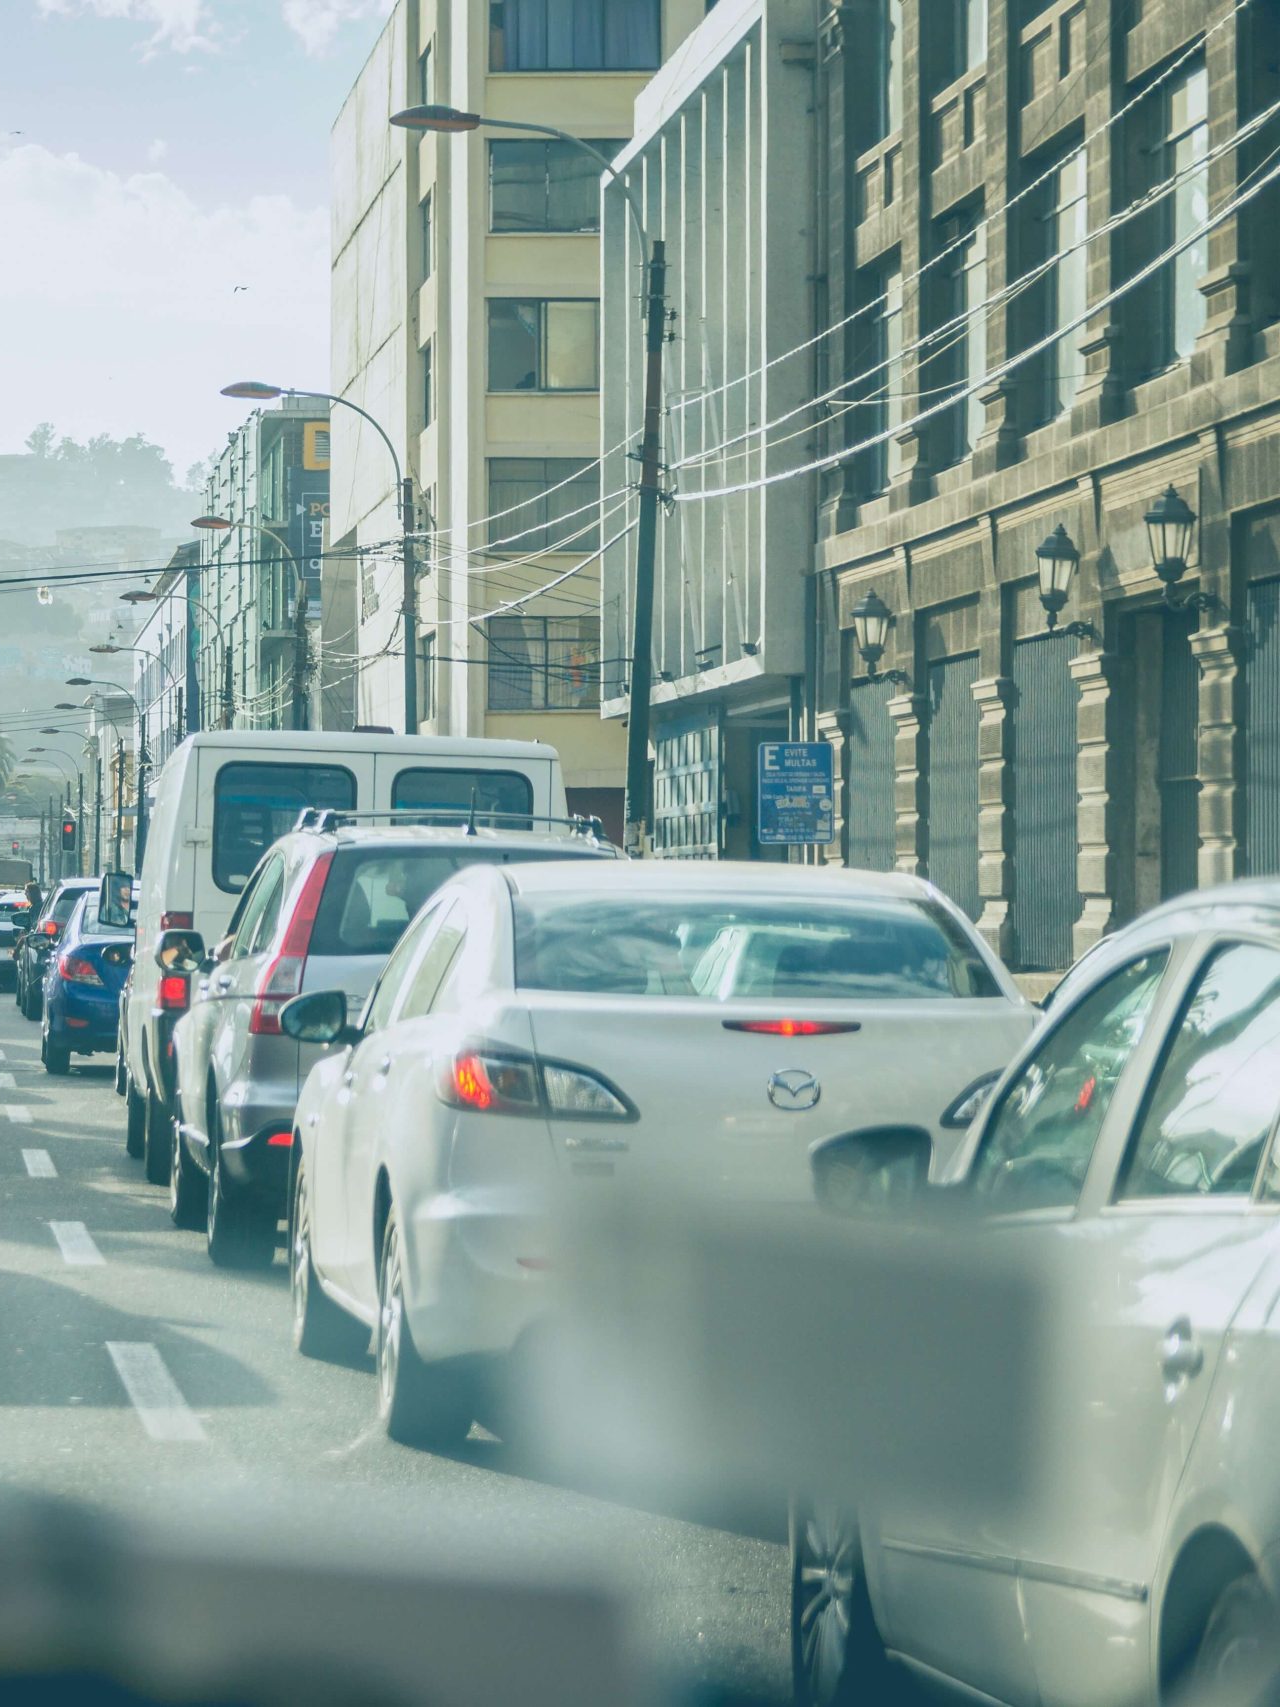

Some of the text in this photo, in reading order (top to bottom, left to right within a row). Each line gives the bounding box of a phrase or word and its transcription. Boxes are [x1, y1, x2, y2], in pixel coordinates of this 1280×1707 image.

[784, 748, 808, 757] EVITE
[764, 746, 780, 770] E
[784, 759, 817, 767] MULTAS
